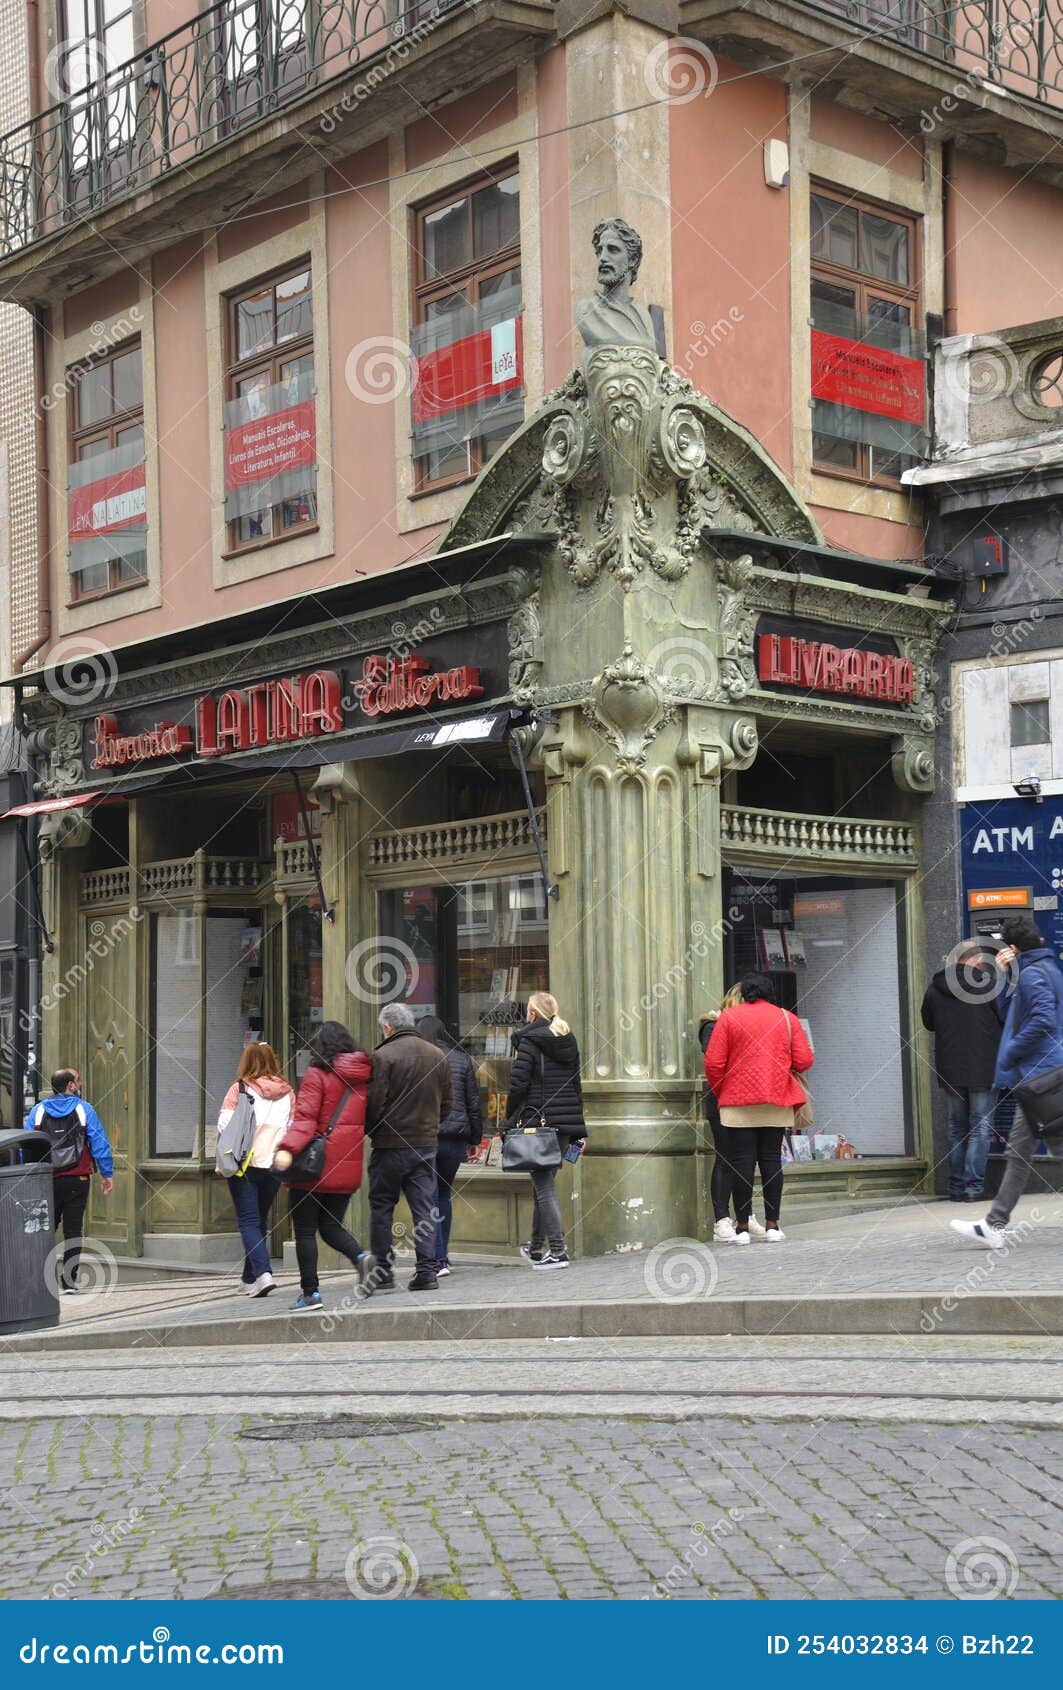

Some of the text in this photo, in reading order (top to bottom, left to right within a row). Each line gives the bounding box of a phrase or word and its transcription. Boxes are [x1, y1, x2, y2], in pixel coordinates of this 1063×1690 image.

[243, 420, 296, 445] Manuais Escolares,
[230, 452, 247, 465] Livros
[274, 447, 296, 463] Infantil
[759, 633, 914, 705] LIVRARIA
[90, 654, 484, 770] Livraria LATINA Editora
[414, 732, 436, 743] LEYA
[972, 826, 1034, 854] ATM
